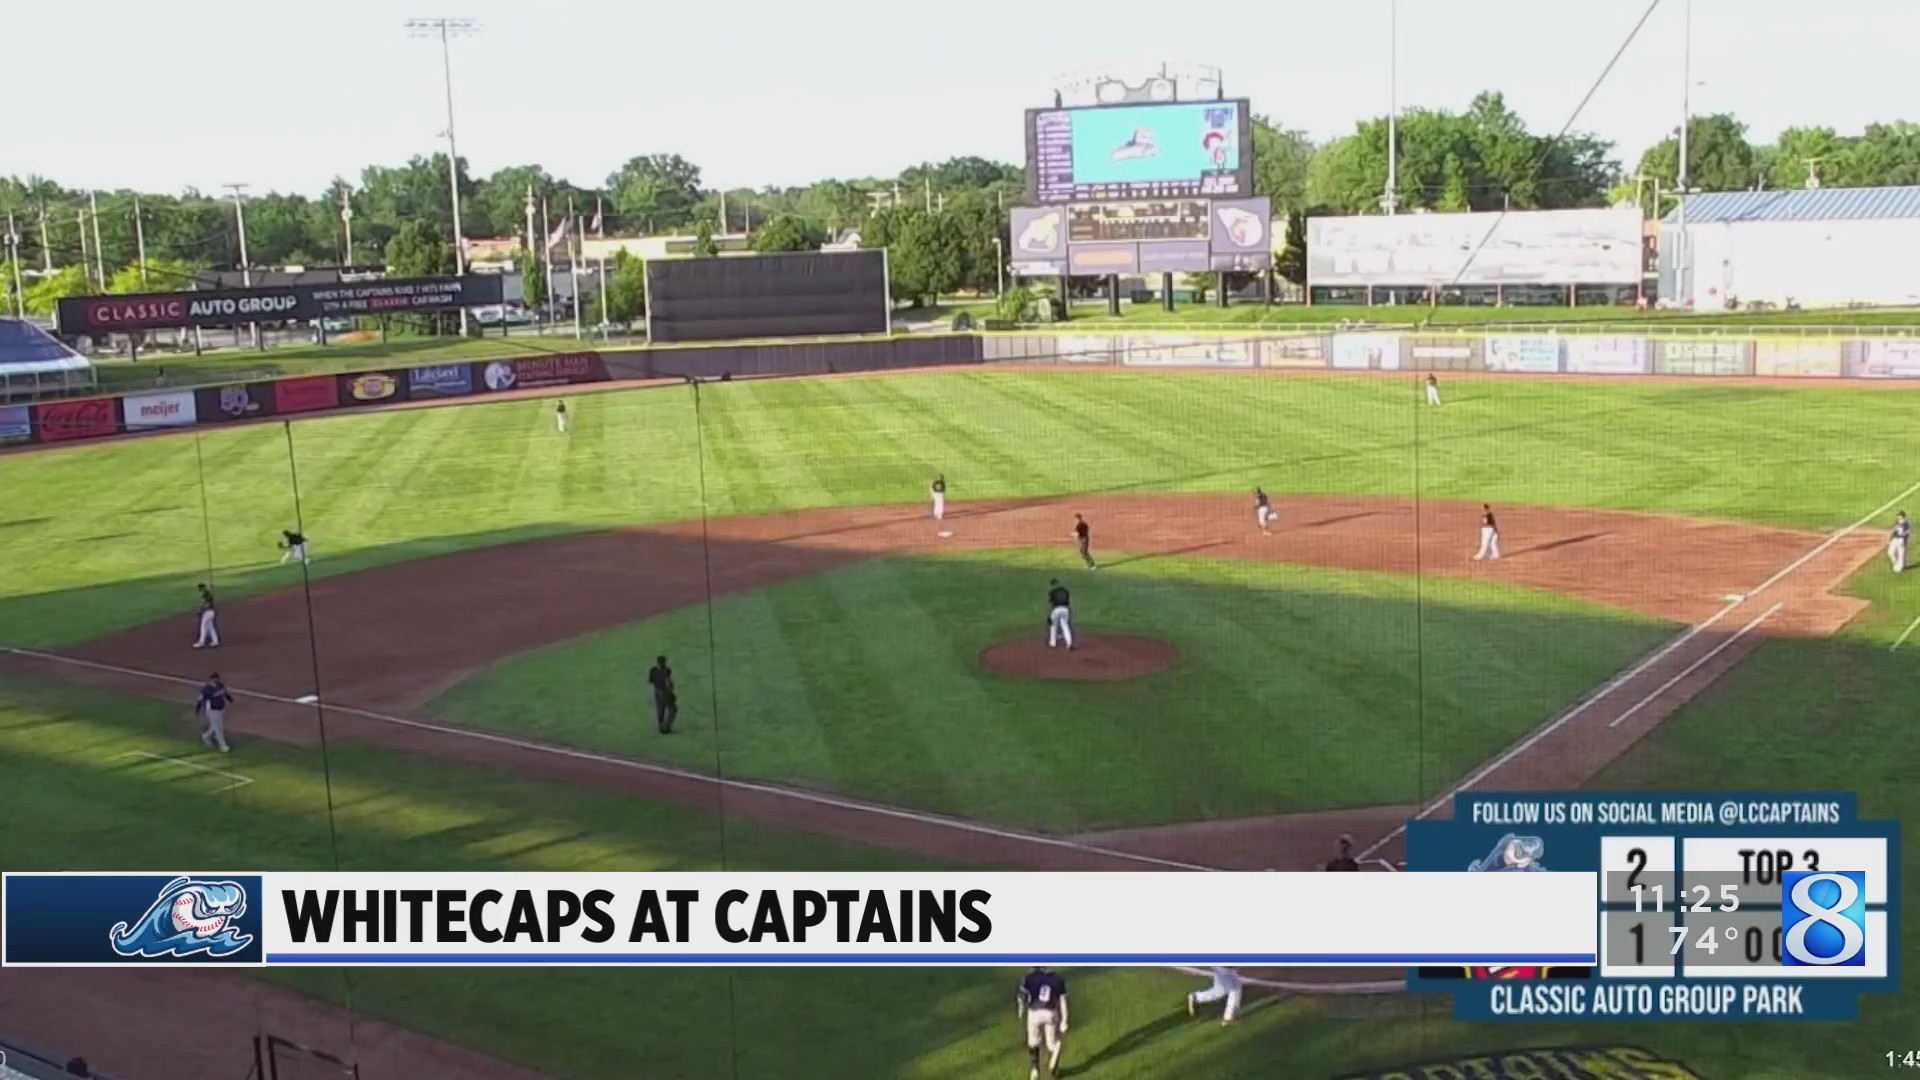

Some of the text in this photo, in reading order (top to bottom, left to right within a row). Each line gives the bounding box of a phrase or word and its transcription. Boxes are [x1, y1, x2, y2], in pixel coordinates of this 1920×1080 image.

[97, 296, 297, 321] CLASSIC AUTO GROUP
[140, 402, 180, 417] meijer
